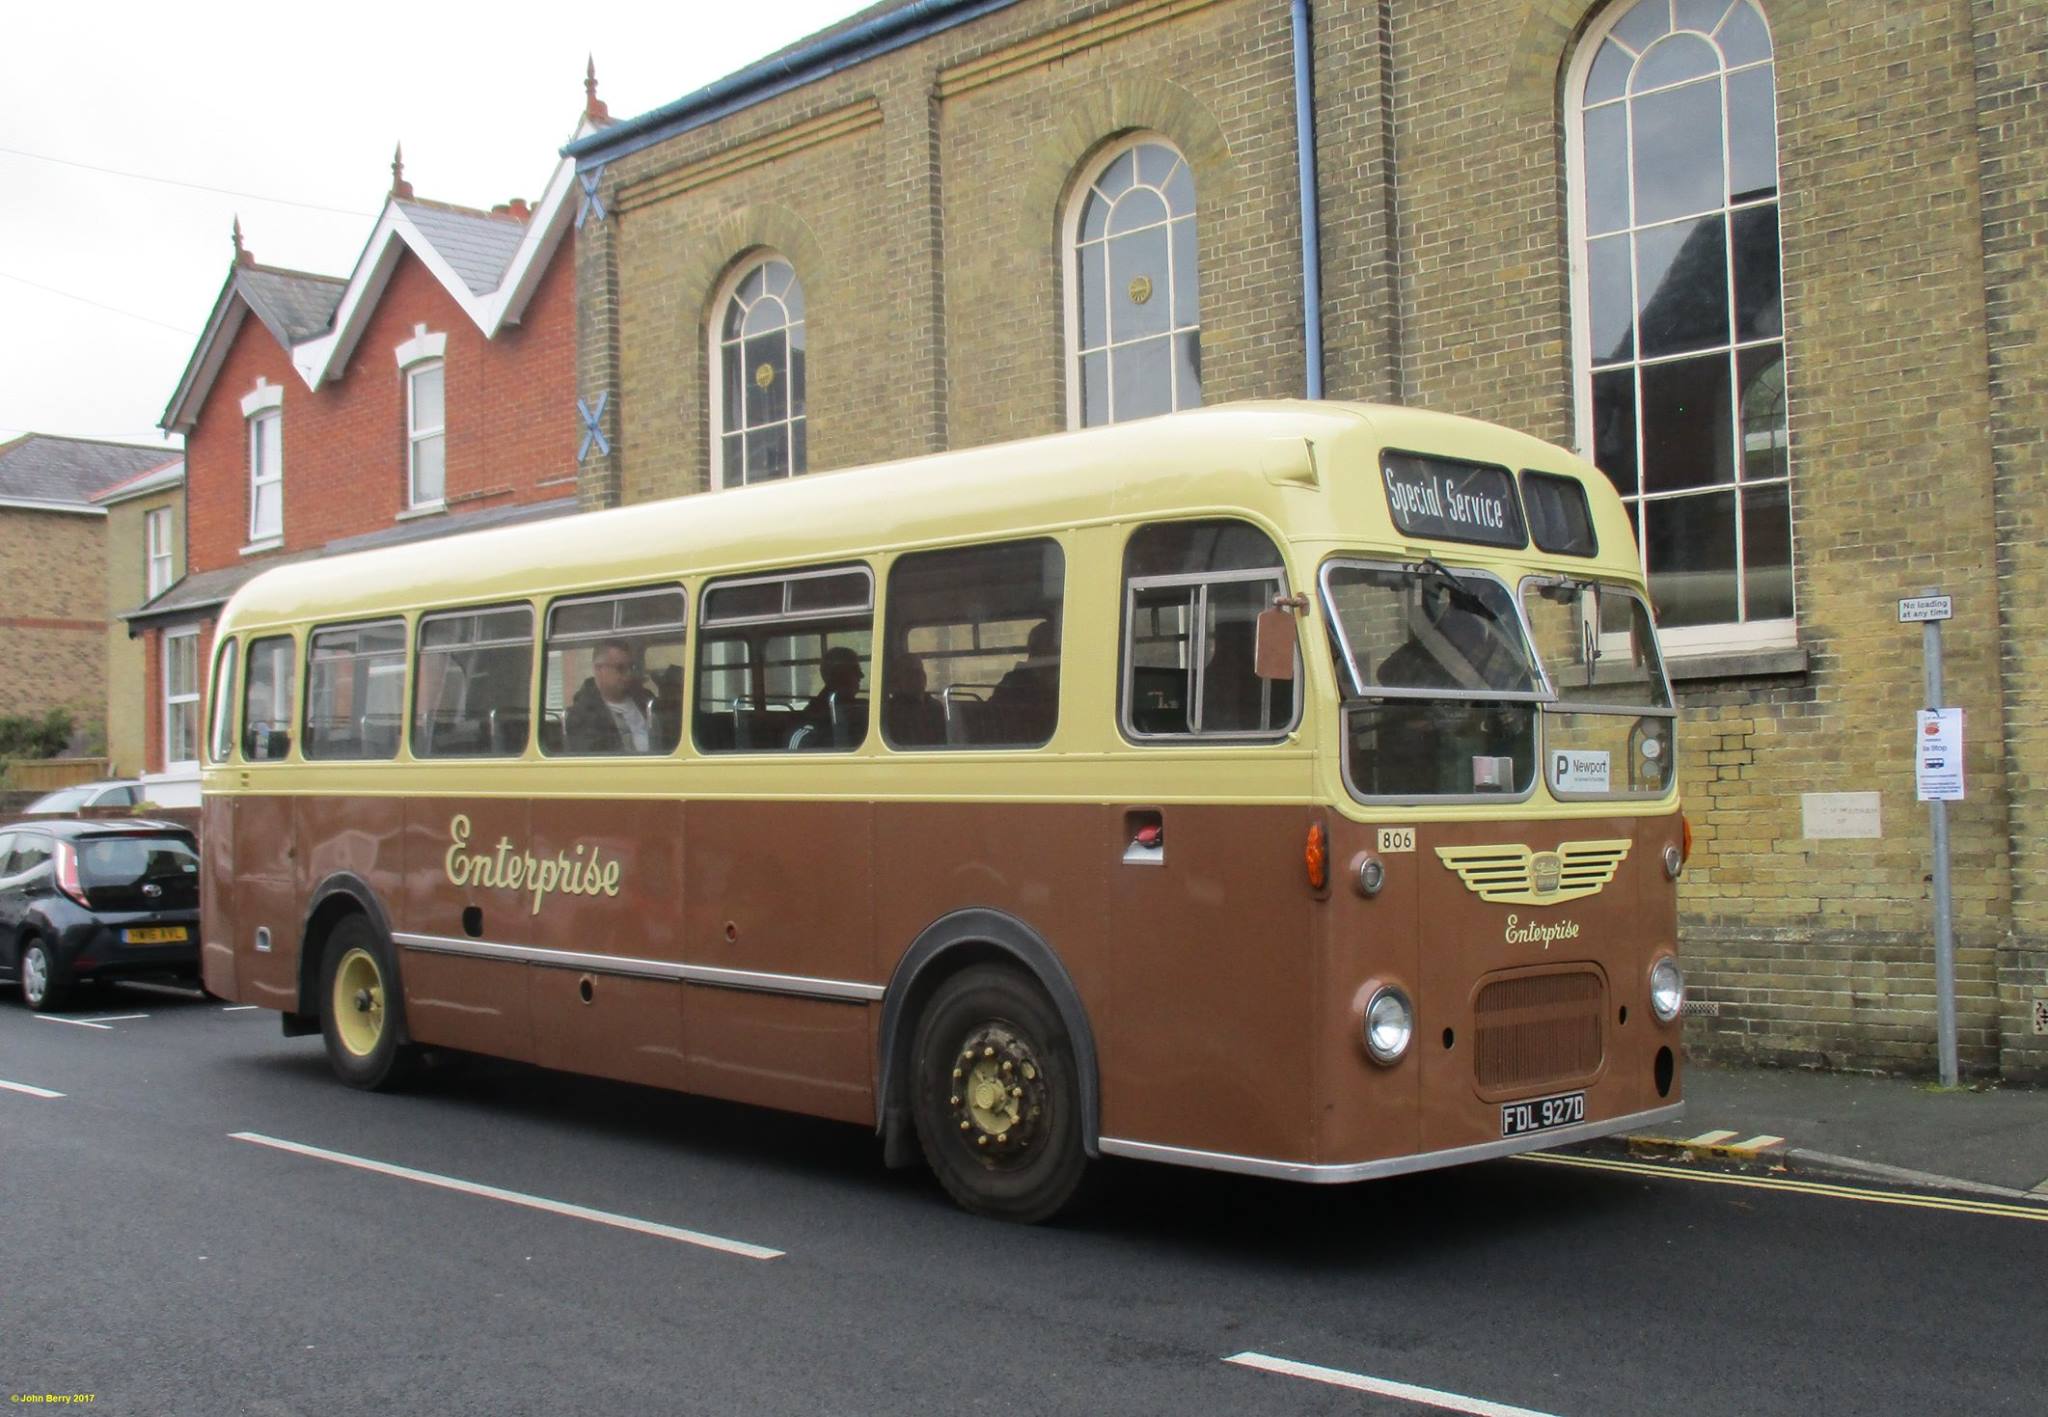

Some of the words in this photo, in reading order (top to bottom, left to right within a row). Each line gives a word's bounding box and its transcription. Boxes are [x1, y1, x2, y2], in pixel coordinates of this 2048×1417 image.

[1385, 467, 1443, 525] Special
[1445, 479, 1504, 529] Service
[1903, 601, 1915, 609] No
[1917, 600, 1948, 609] loading
[1930, 609, 1949, 617] time
[1556, 755, 1569, 785] P
[1573, 759, 1607, 776] Newport
[1383, 832, 1412, 849] 806
[445, 813, 620, 916] Enterprise
[1505, 914, 1580, 950] Enterprise
[1503, 1104, 1540, 1134] FDL
[1542, 1095, 1585, 1126] 927D
